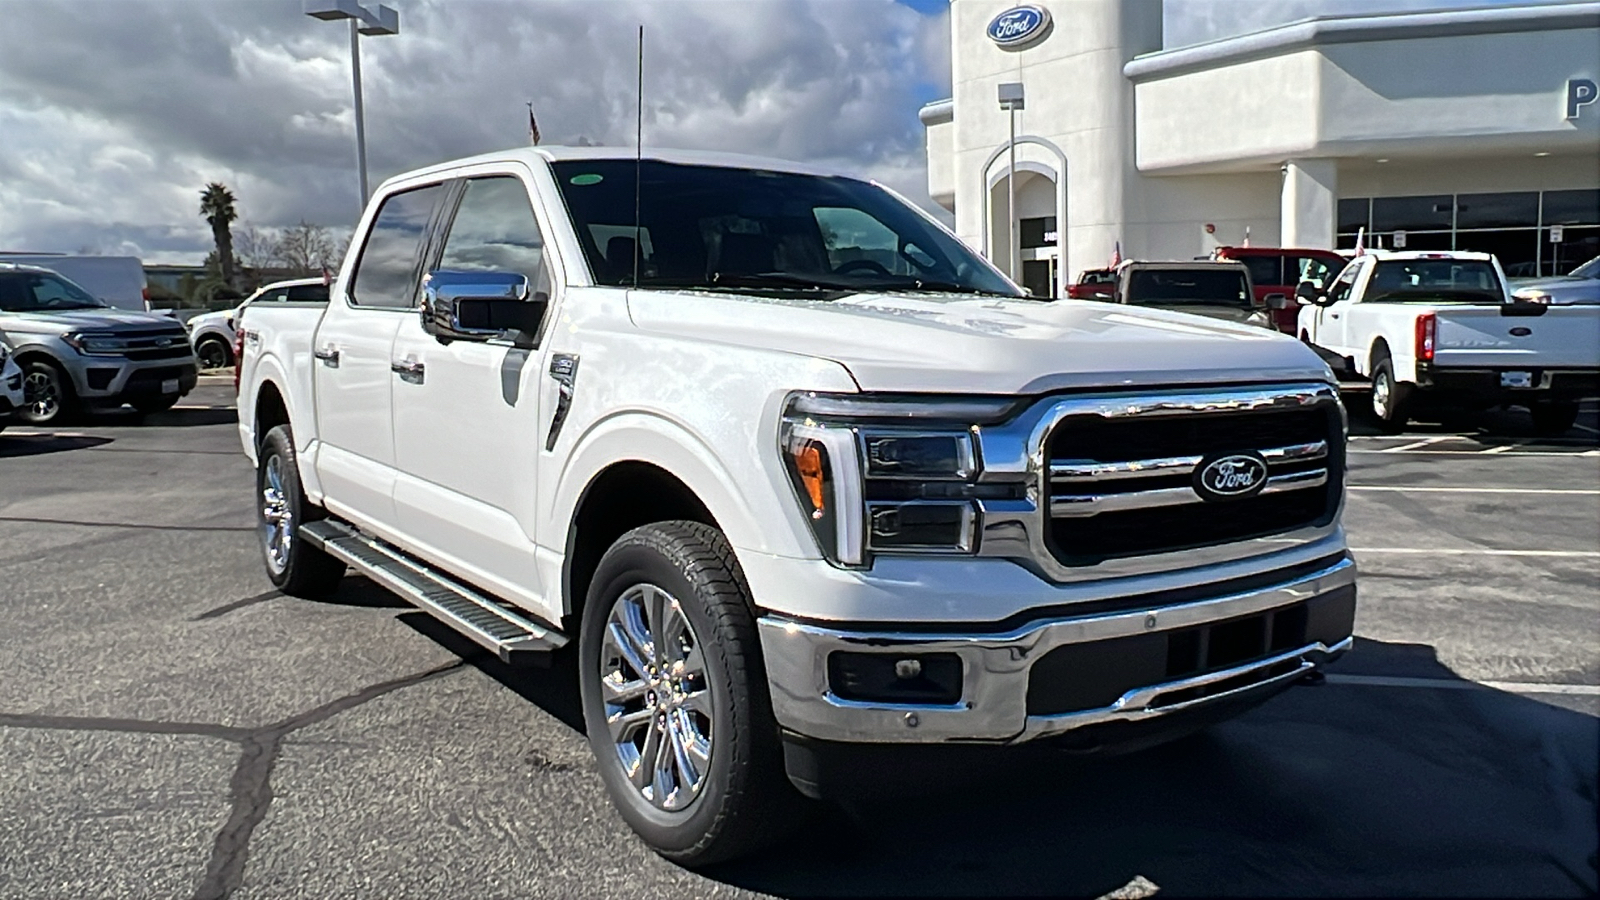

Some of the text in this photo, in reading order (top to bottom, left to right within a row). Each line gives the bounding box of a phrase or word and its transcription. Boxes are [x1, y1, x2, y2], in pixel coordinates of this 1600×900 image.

[996, 12, 1031, 38] Ford
[1567, 79, 1599, 118] P
[1214, 461, 1255, 489] Ford
